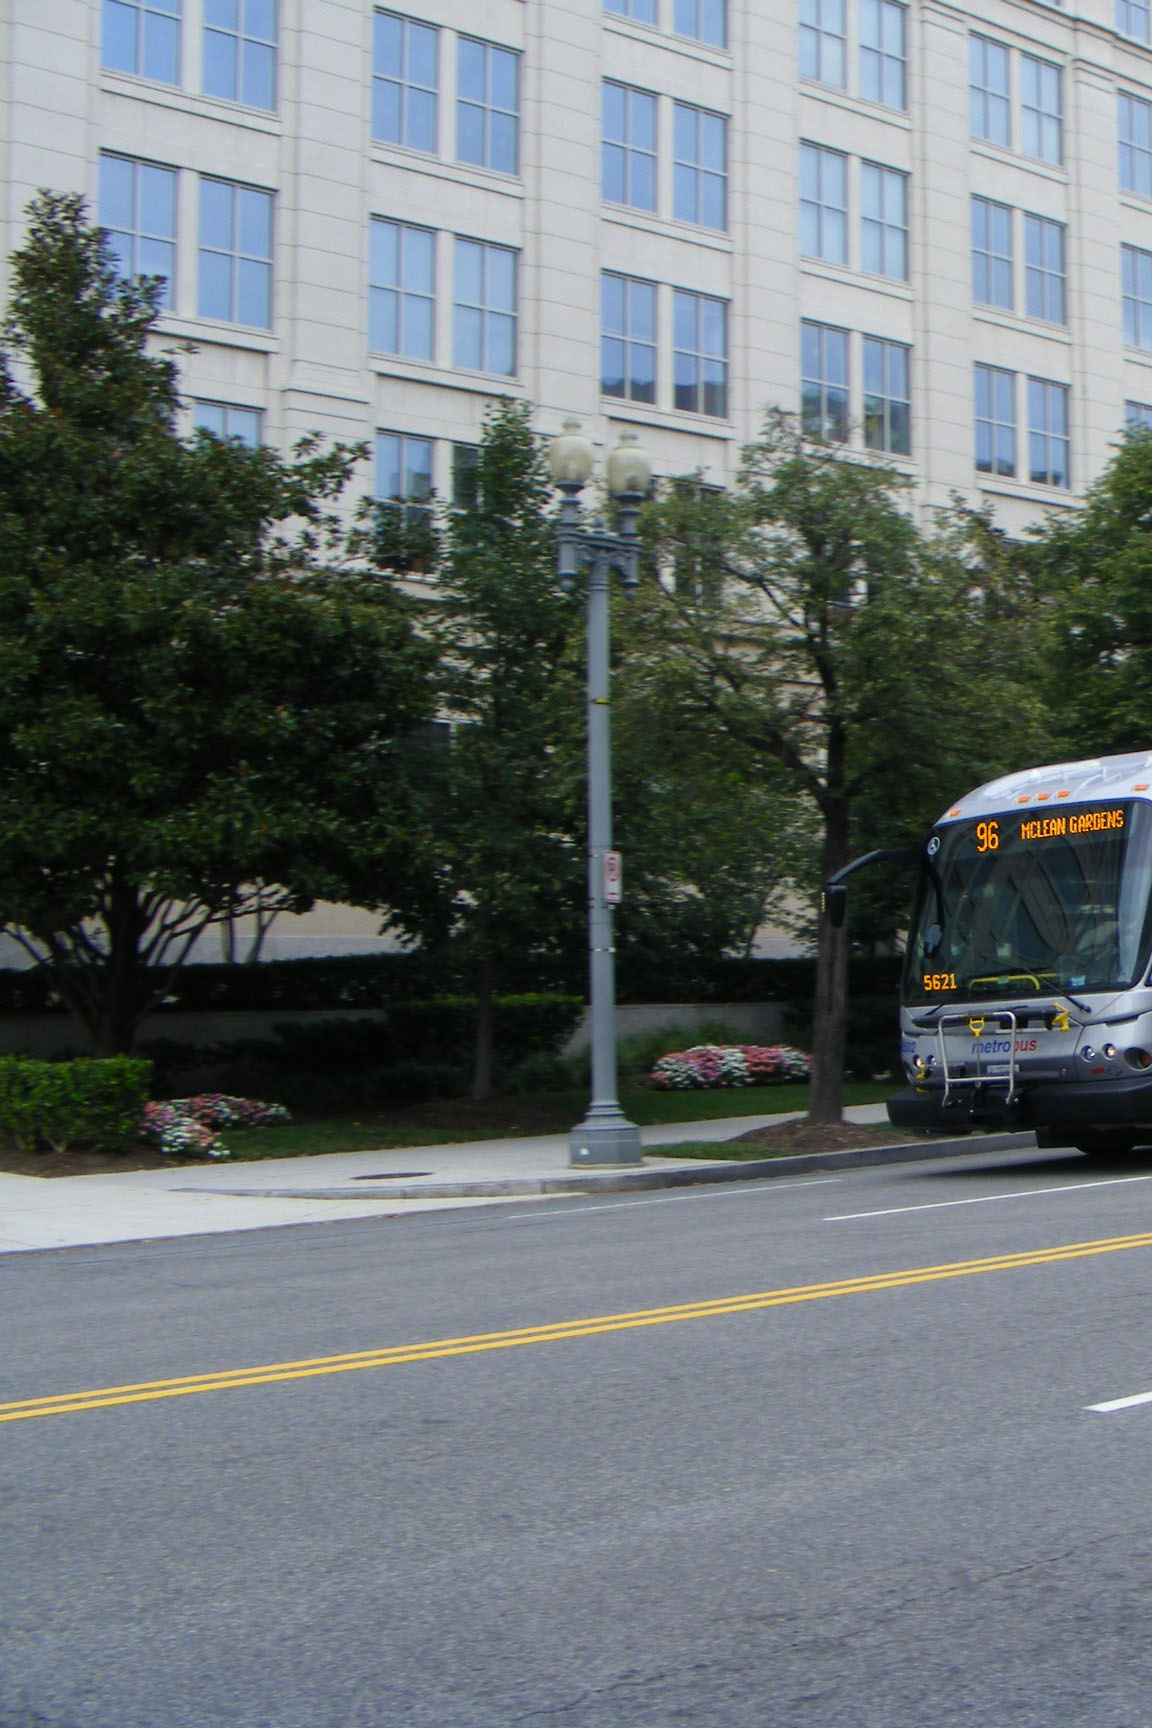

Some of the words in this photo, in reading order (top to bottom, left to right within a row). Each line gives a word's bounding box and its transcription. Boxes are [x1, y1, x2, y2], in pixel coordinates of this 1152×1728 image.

[976, 822, 999, 852] 96
[1021, 817, 1066, 840] MCLEAN
[1069, 809, 1124, 834] GARDENS
[923, 973, 957, 991] 5621
